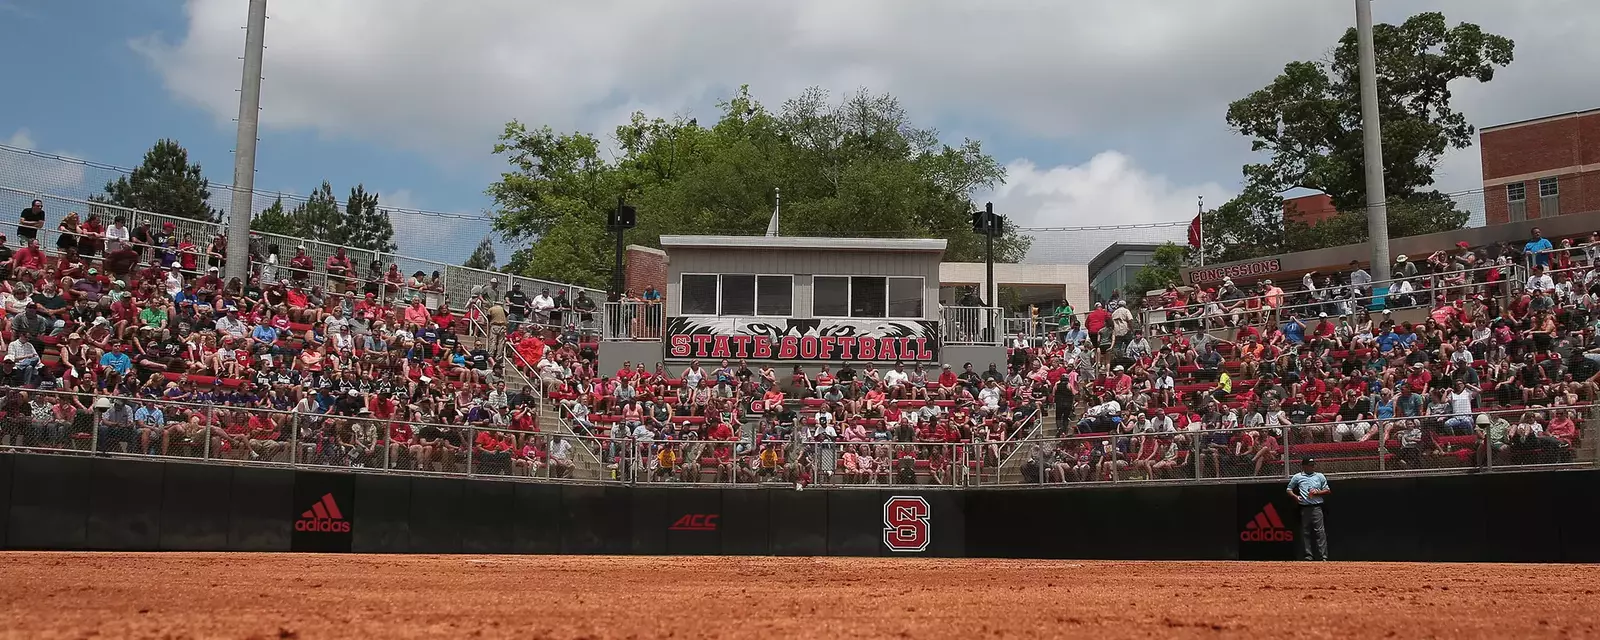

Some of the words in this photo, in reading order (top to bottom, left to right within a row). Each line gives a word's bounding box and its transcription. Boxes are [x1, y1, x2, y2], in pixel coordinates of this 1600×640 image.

[1191, 260, 1279, 282] CONCESSIONS
[295, 517, 351, 532] adidas
[671, 514, 720, 529] ACC
[1240, 528, 1294, 542] adidas
